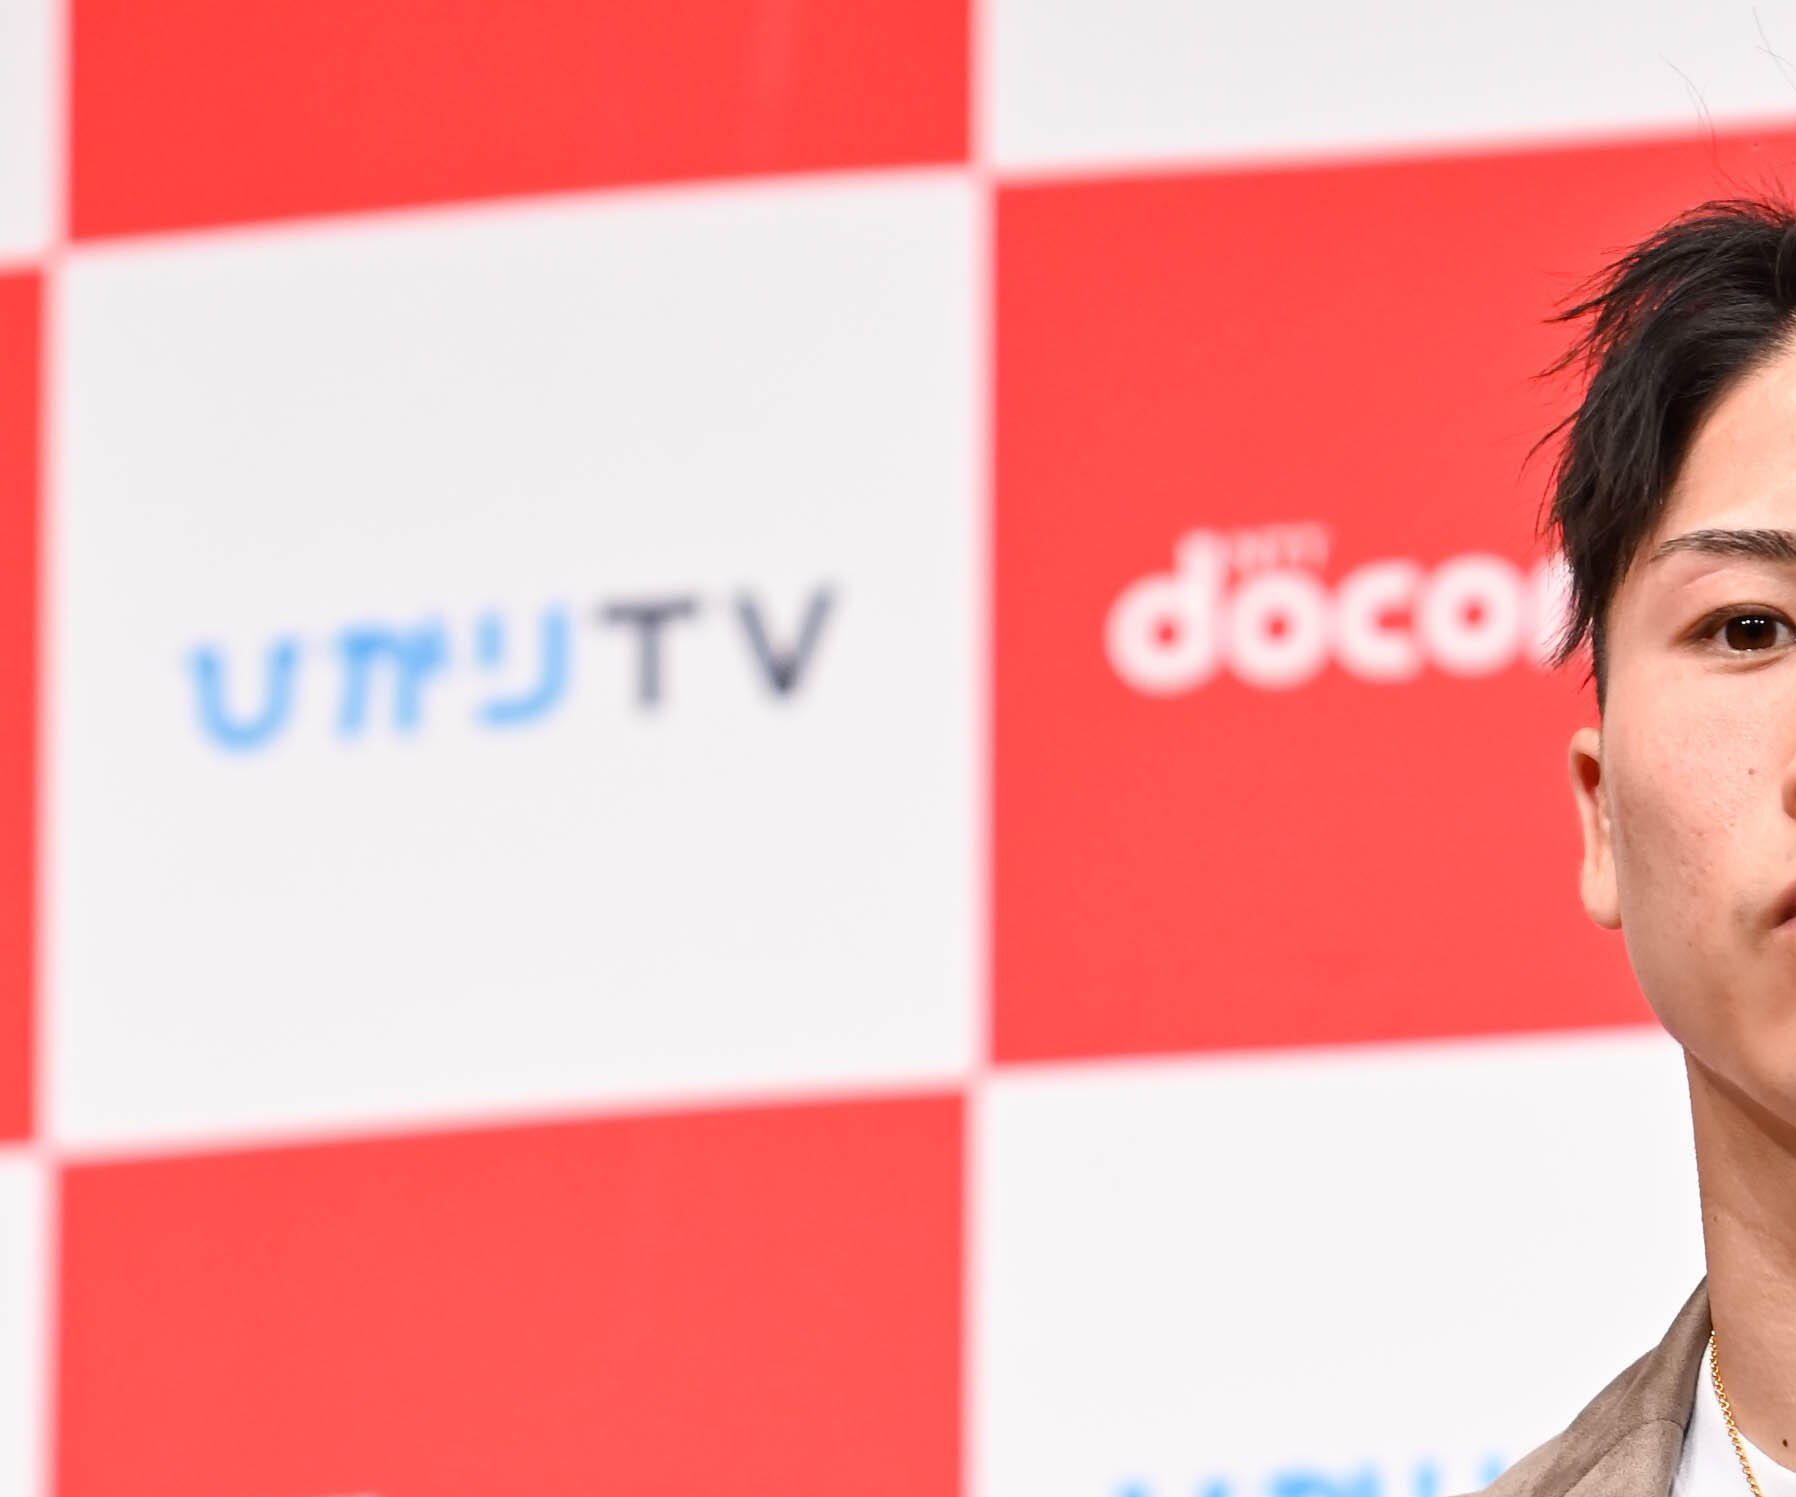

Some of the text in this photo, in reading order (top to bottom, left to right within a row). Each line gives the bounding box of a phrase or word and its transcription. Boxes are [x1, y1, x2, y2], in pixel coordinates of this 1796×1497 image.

[190, 588, 836, 752] ひかりTV
[1104, 530, 1583, 696] doco
